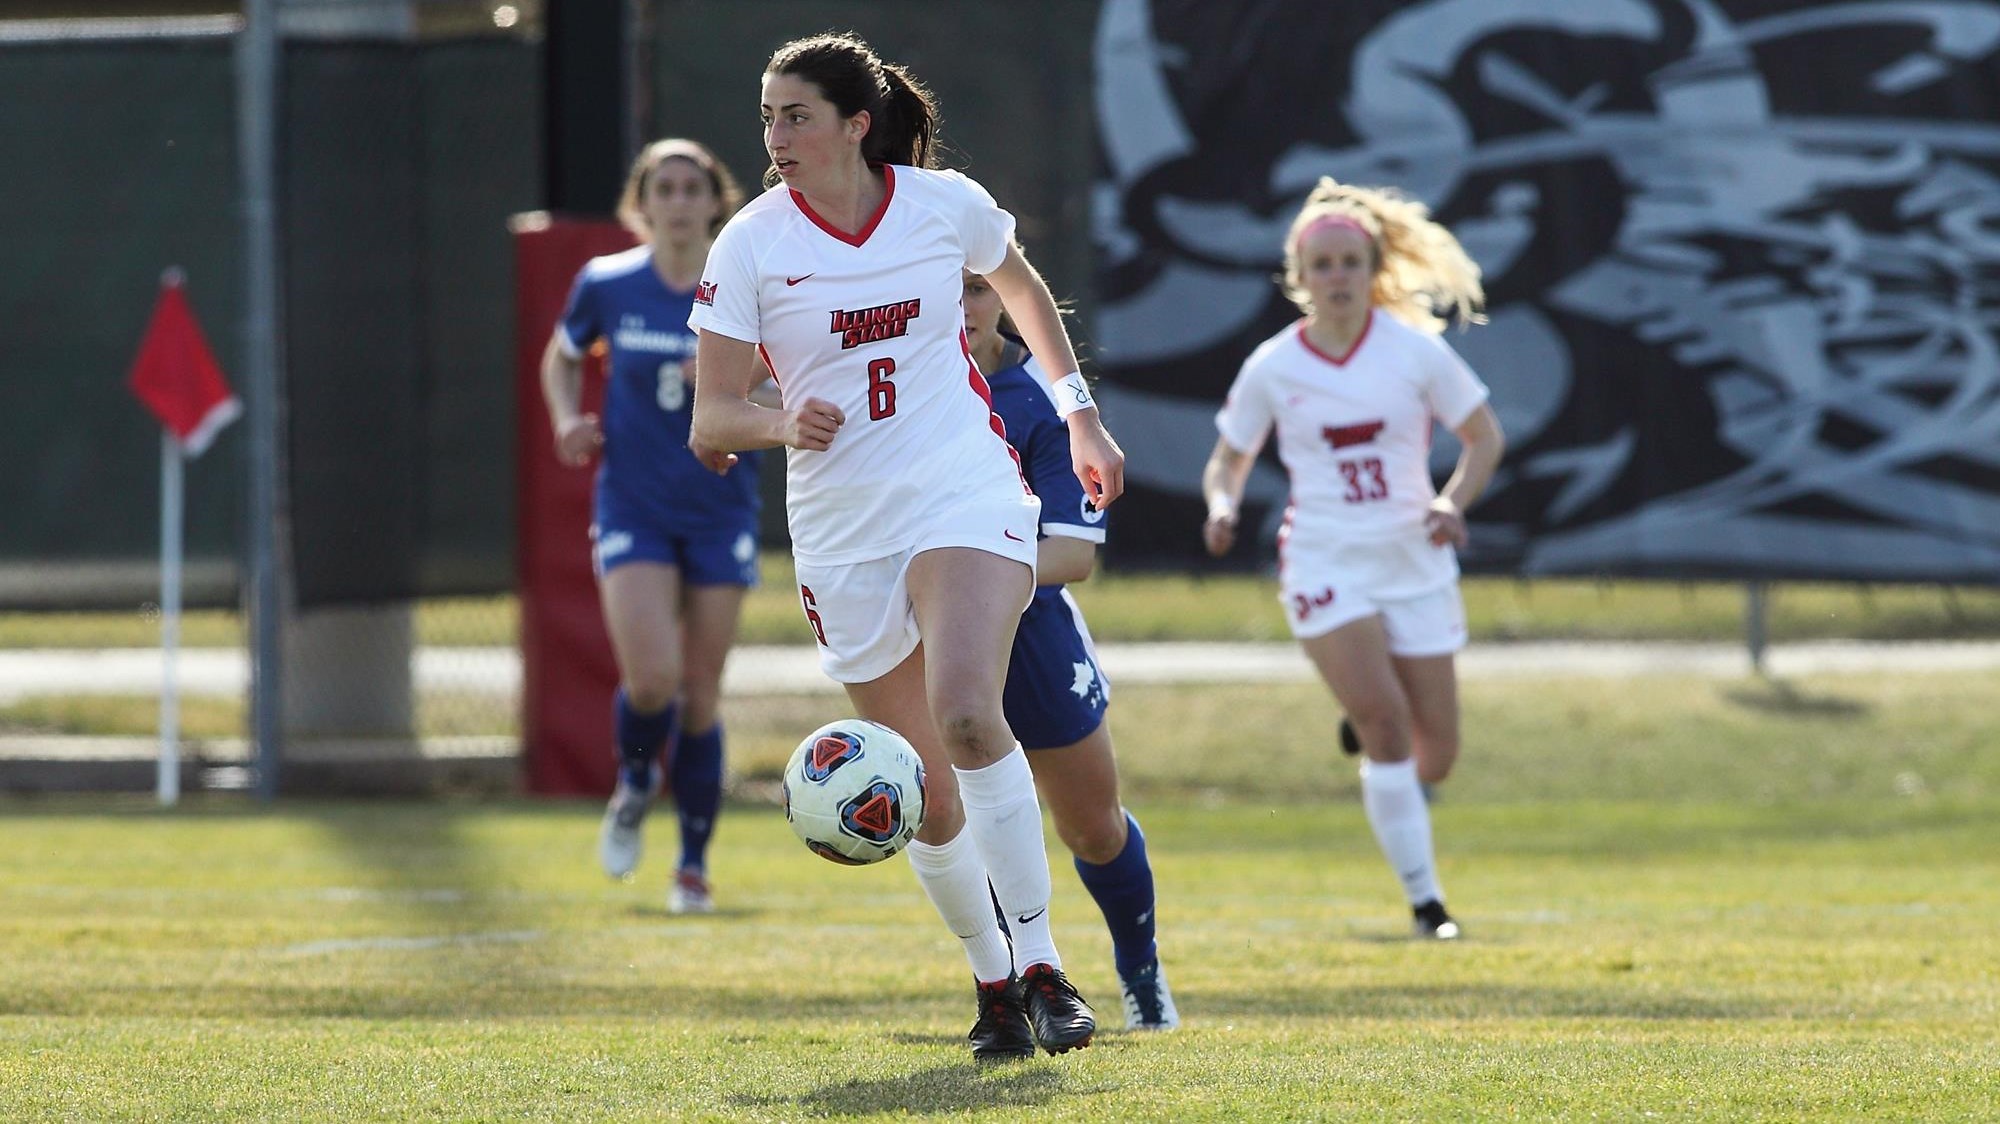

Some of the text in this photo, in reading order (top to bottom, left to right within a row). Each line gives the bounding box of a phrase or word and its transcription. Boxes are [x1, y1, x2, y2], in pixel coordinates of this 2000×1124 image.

[829, 298, 920, 334] ILLINOIS
[841, 318, 907, 350] STATE
[656, 361, 685, 412] 8
[867, 357, 897, 421] 6
[1339, 459, 1389, 503] 33
[801, 583, 828, 648] 6
